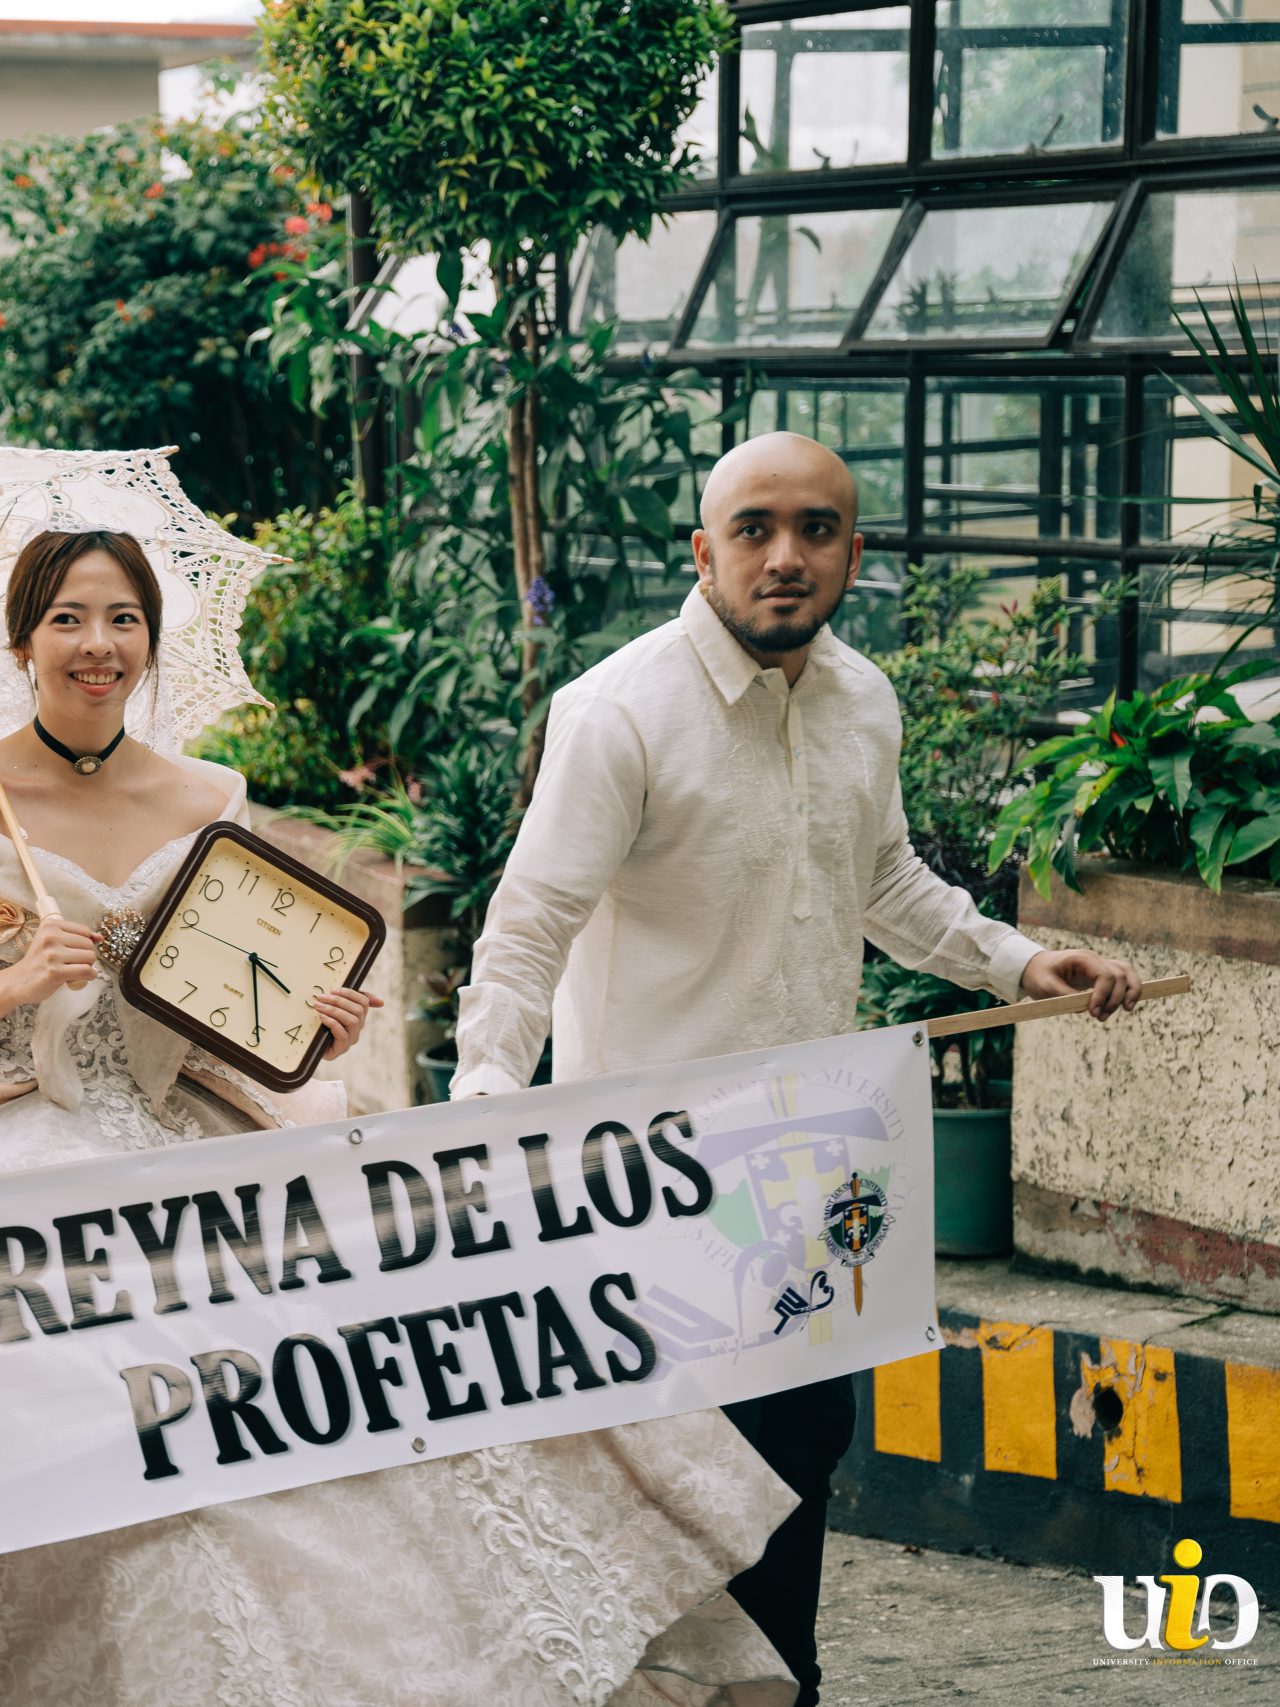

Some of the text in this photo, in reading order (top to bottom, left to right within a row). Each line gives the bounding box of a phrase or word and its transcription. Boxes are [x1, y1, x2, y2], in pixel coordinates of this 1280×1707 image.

[198, 874, 224, 902] 10
[238, 869, 260, 896] 11
[271, 887, 295, 917] 12
[179, 908, 200, 930] 9
[256, 917, 283, 937] CITIZEN
[309, 912, 323, 934] 1
[159, 945, 180, 969] 8
[323, 946, 345, 972] 2
[177, 980, 199, 1004] 7
[209, 1006, 231, 1028] 6
[245, 1025, 267, 1048] 5
[284, 1024, 303, 1046] 4
[799, 1067, 906, 1142] NIVERSITY
[360, 1142, 513, 1274] DE
[517, 1109, 715, 1245] LOS
[119, 1272, 658, 1482] PROFETAS
